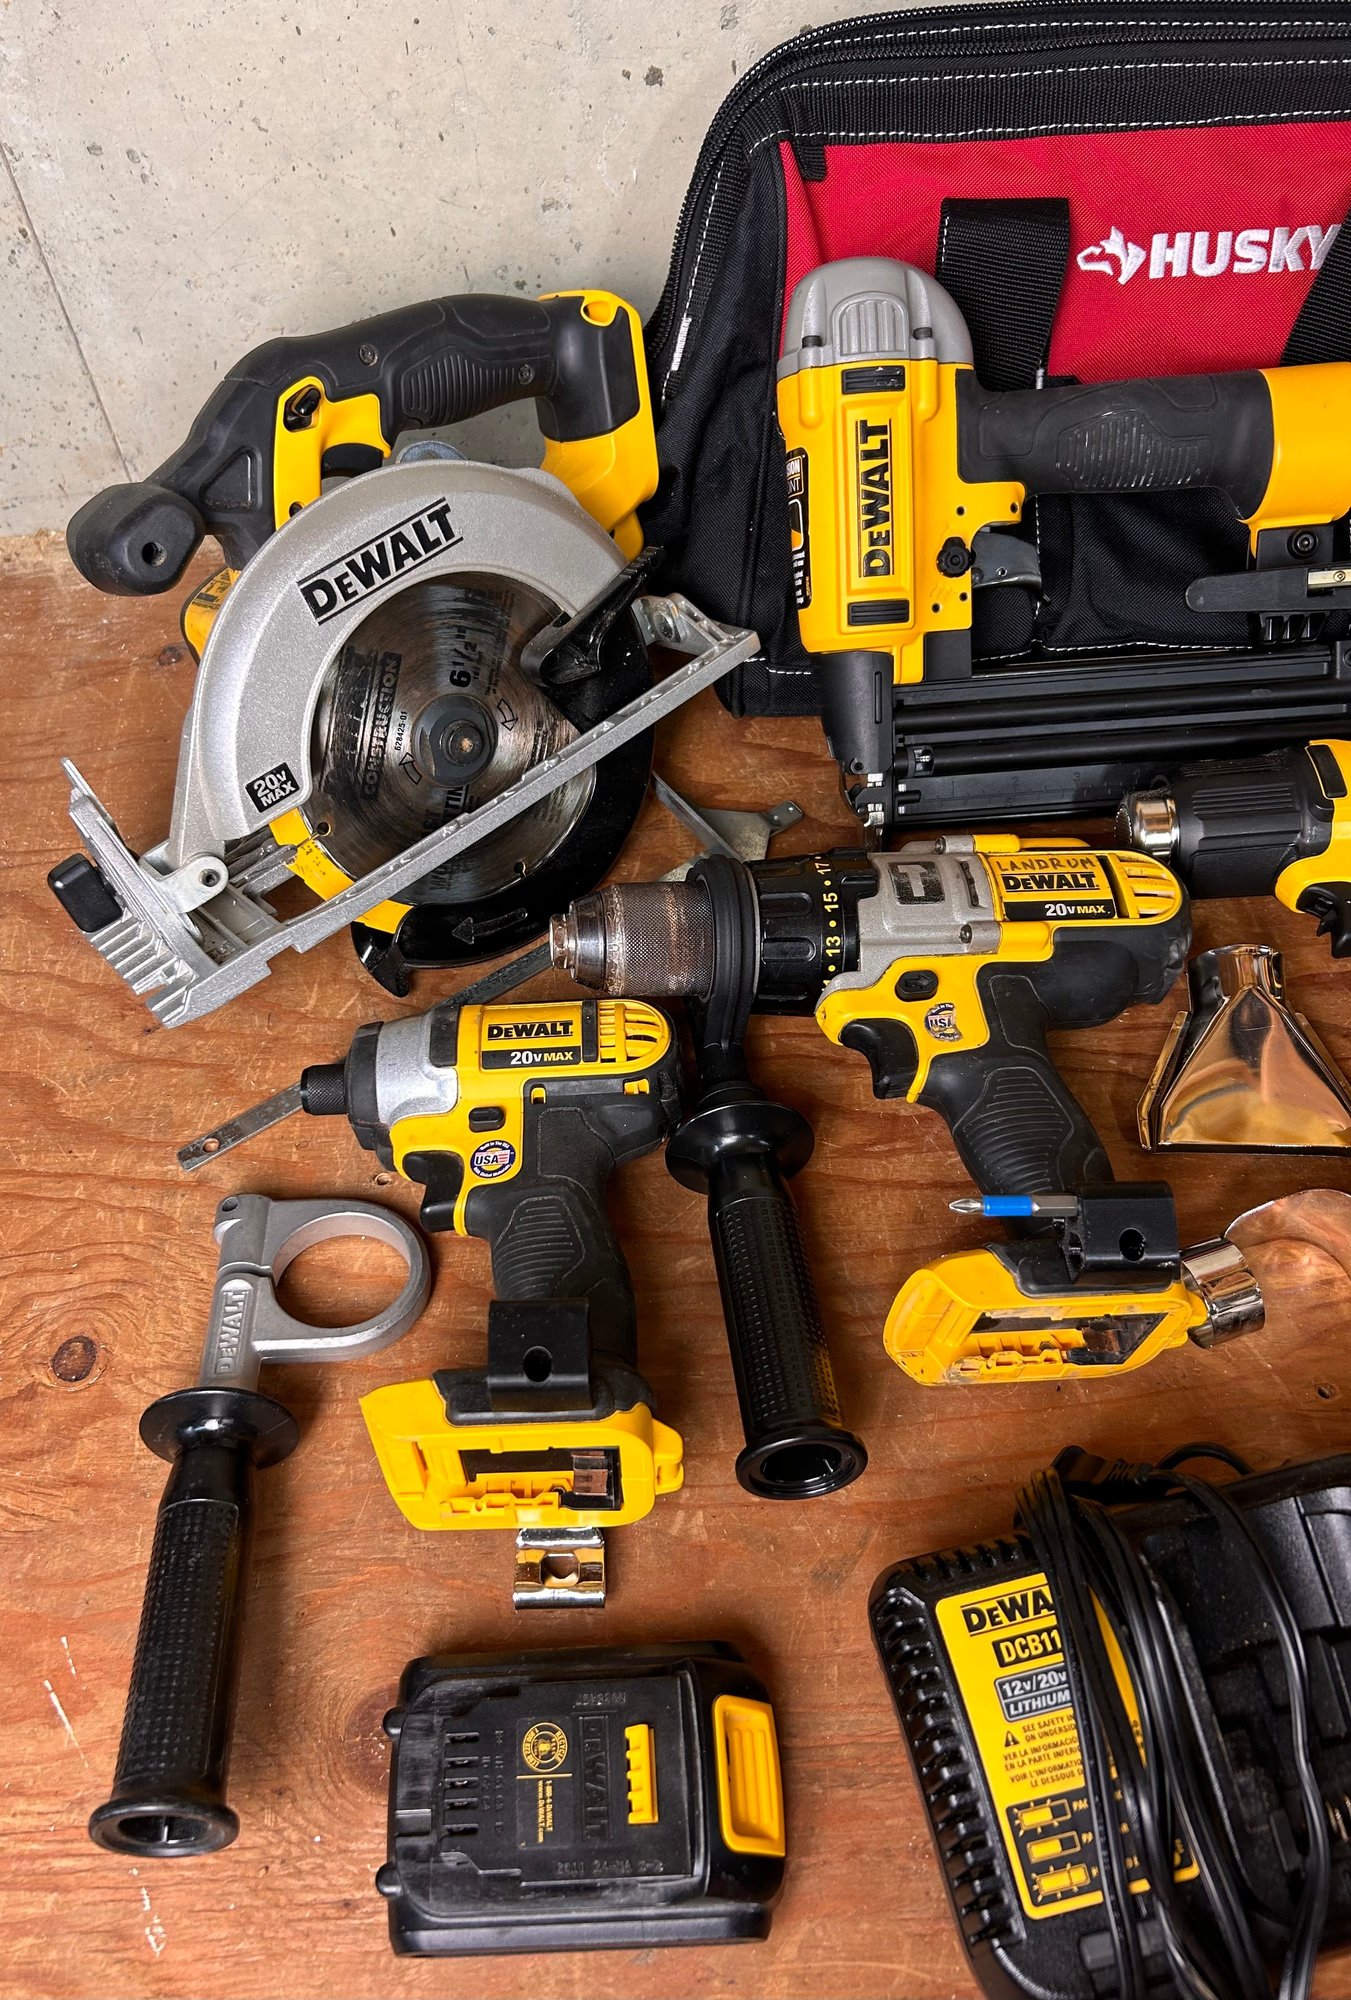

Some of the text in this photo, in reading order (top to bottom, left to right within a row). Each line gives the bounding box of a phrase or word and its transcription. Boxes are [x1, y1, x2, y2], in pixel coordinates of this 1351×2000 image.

[1149, 224, 1342, 279] HUSKY
[260, 780, 296, 807] MAX
[815, 862, 832, 875] 17
[996, 856, 1096, 873] LANDRUM
[823, 892, 840, 913] 15
[826, 935, 841, 957] 13
[543, 1051, 574, 1062] MAX
[475, 1155, 499, 1165] USA
[962, 1588, 1055, 1634] DEWA
[1000, 1629, 1062, 1663] DCB11
[1009, 1689, 1072, 1716] LITHIUM
[1022, 1723, 1036, 1733] SEE
[1038, 1716, 1065, 1729] SAFETY
[1025, 1723, 1077, 1743] ON UNDERSID
[1003, 1751, 1018, 1761] VER
[1019, 1749, 1029, 1757] LA
[1005, 1746, 1081, 1771] EN LA PARTE INFERIO
[1010, 1758, 1083, 1783] VOIR L'INFORMATIO
[1030, 1780, 1039, 1788] LE
[1041, 1770, 1076, 1785] DESSOUS
